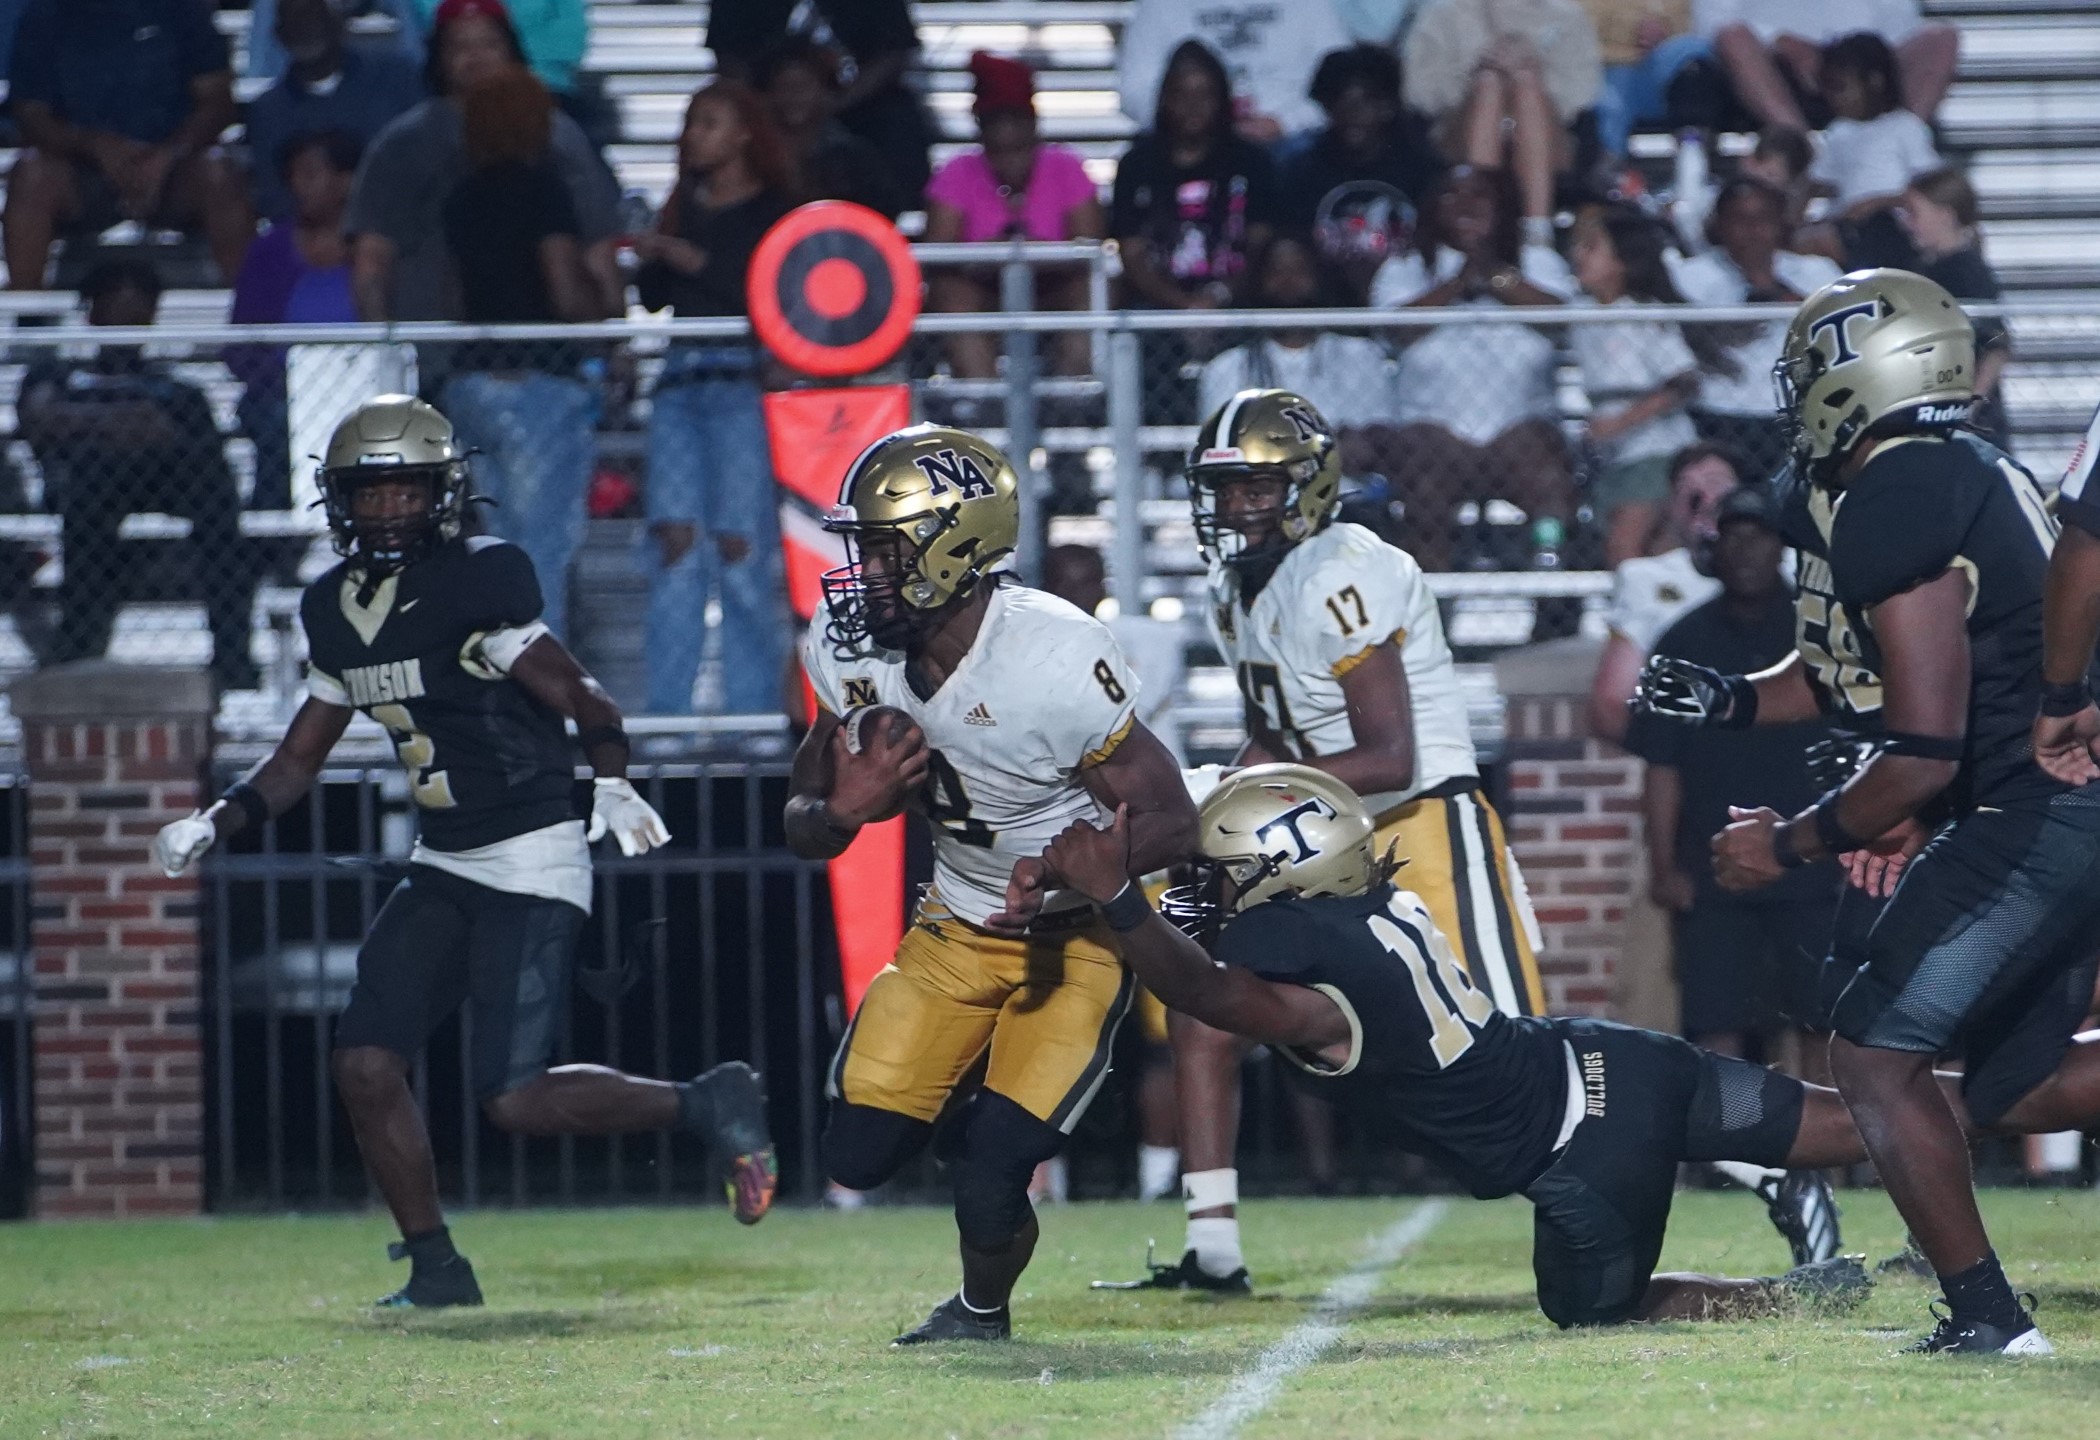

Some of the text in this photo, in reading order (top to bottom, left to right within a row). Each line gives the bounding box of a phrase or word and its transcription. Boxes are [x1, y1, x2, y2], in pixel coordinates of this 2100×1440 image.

[1809, 299, 1880, 371] T
[913, 448, 997, 501] NA
[1325, 584, 1370, 637] 17
[842, 677, 881, 708] NA
[1094, 658, 1126, 705] 8
[963, 716, 998, 727] adidas
[371, 703, 457, 808] 2
[1253, 795, 1338, 868] T
[1583, 1051, 1606, 1118] BULLDOGS
